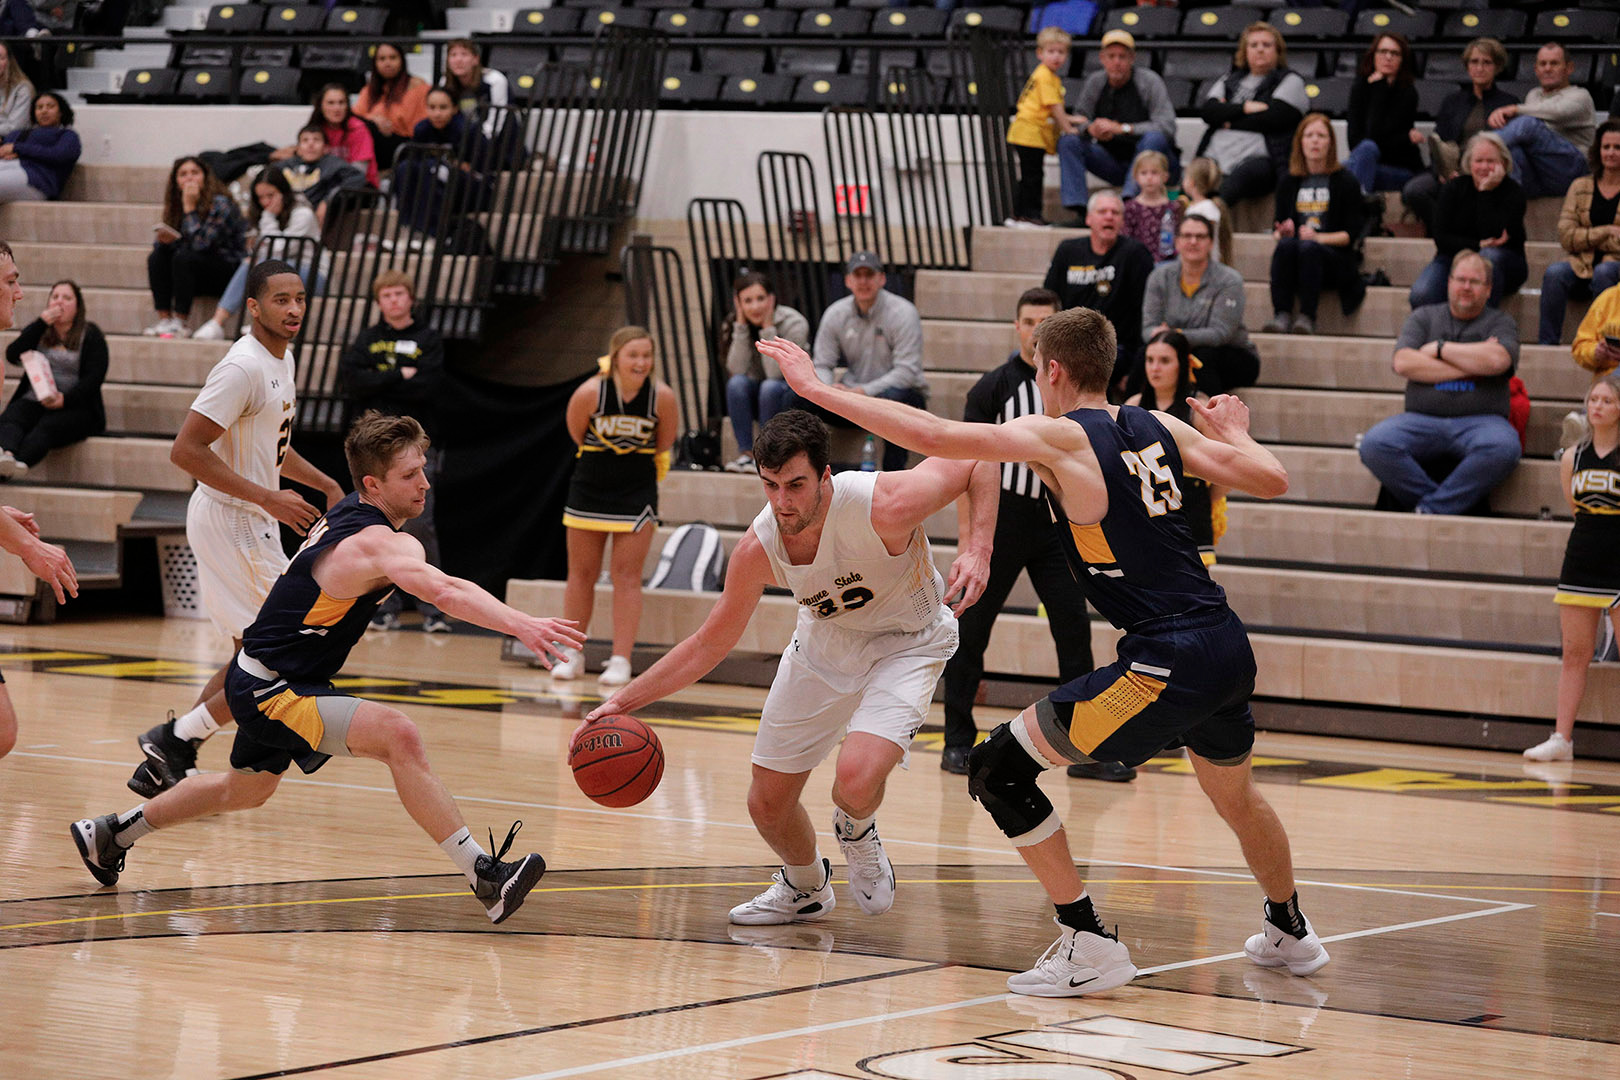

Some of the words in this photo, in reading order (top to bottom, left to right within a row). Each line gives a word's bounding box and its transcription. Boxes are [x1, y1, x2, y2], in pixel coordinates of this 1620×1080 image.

[276, 415, 297, 467] 2
[594, 415, 656, 440] WSC
[1120, 441, 1183, 518] 25
[1572, 469, 1620, 497] WSC
[834, 572, 863, 589] State
